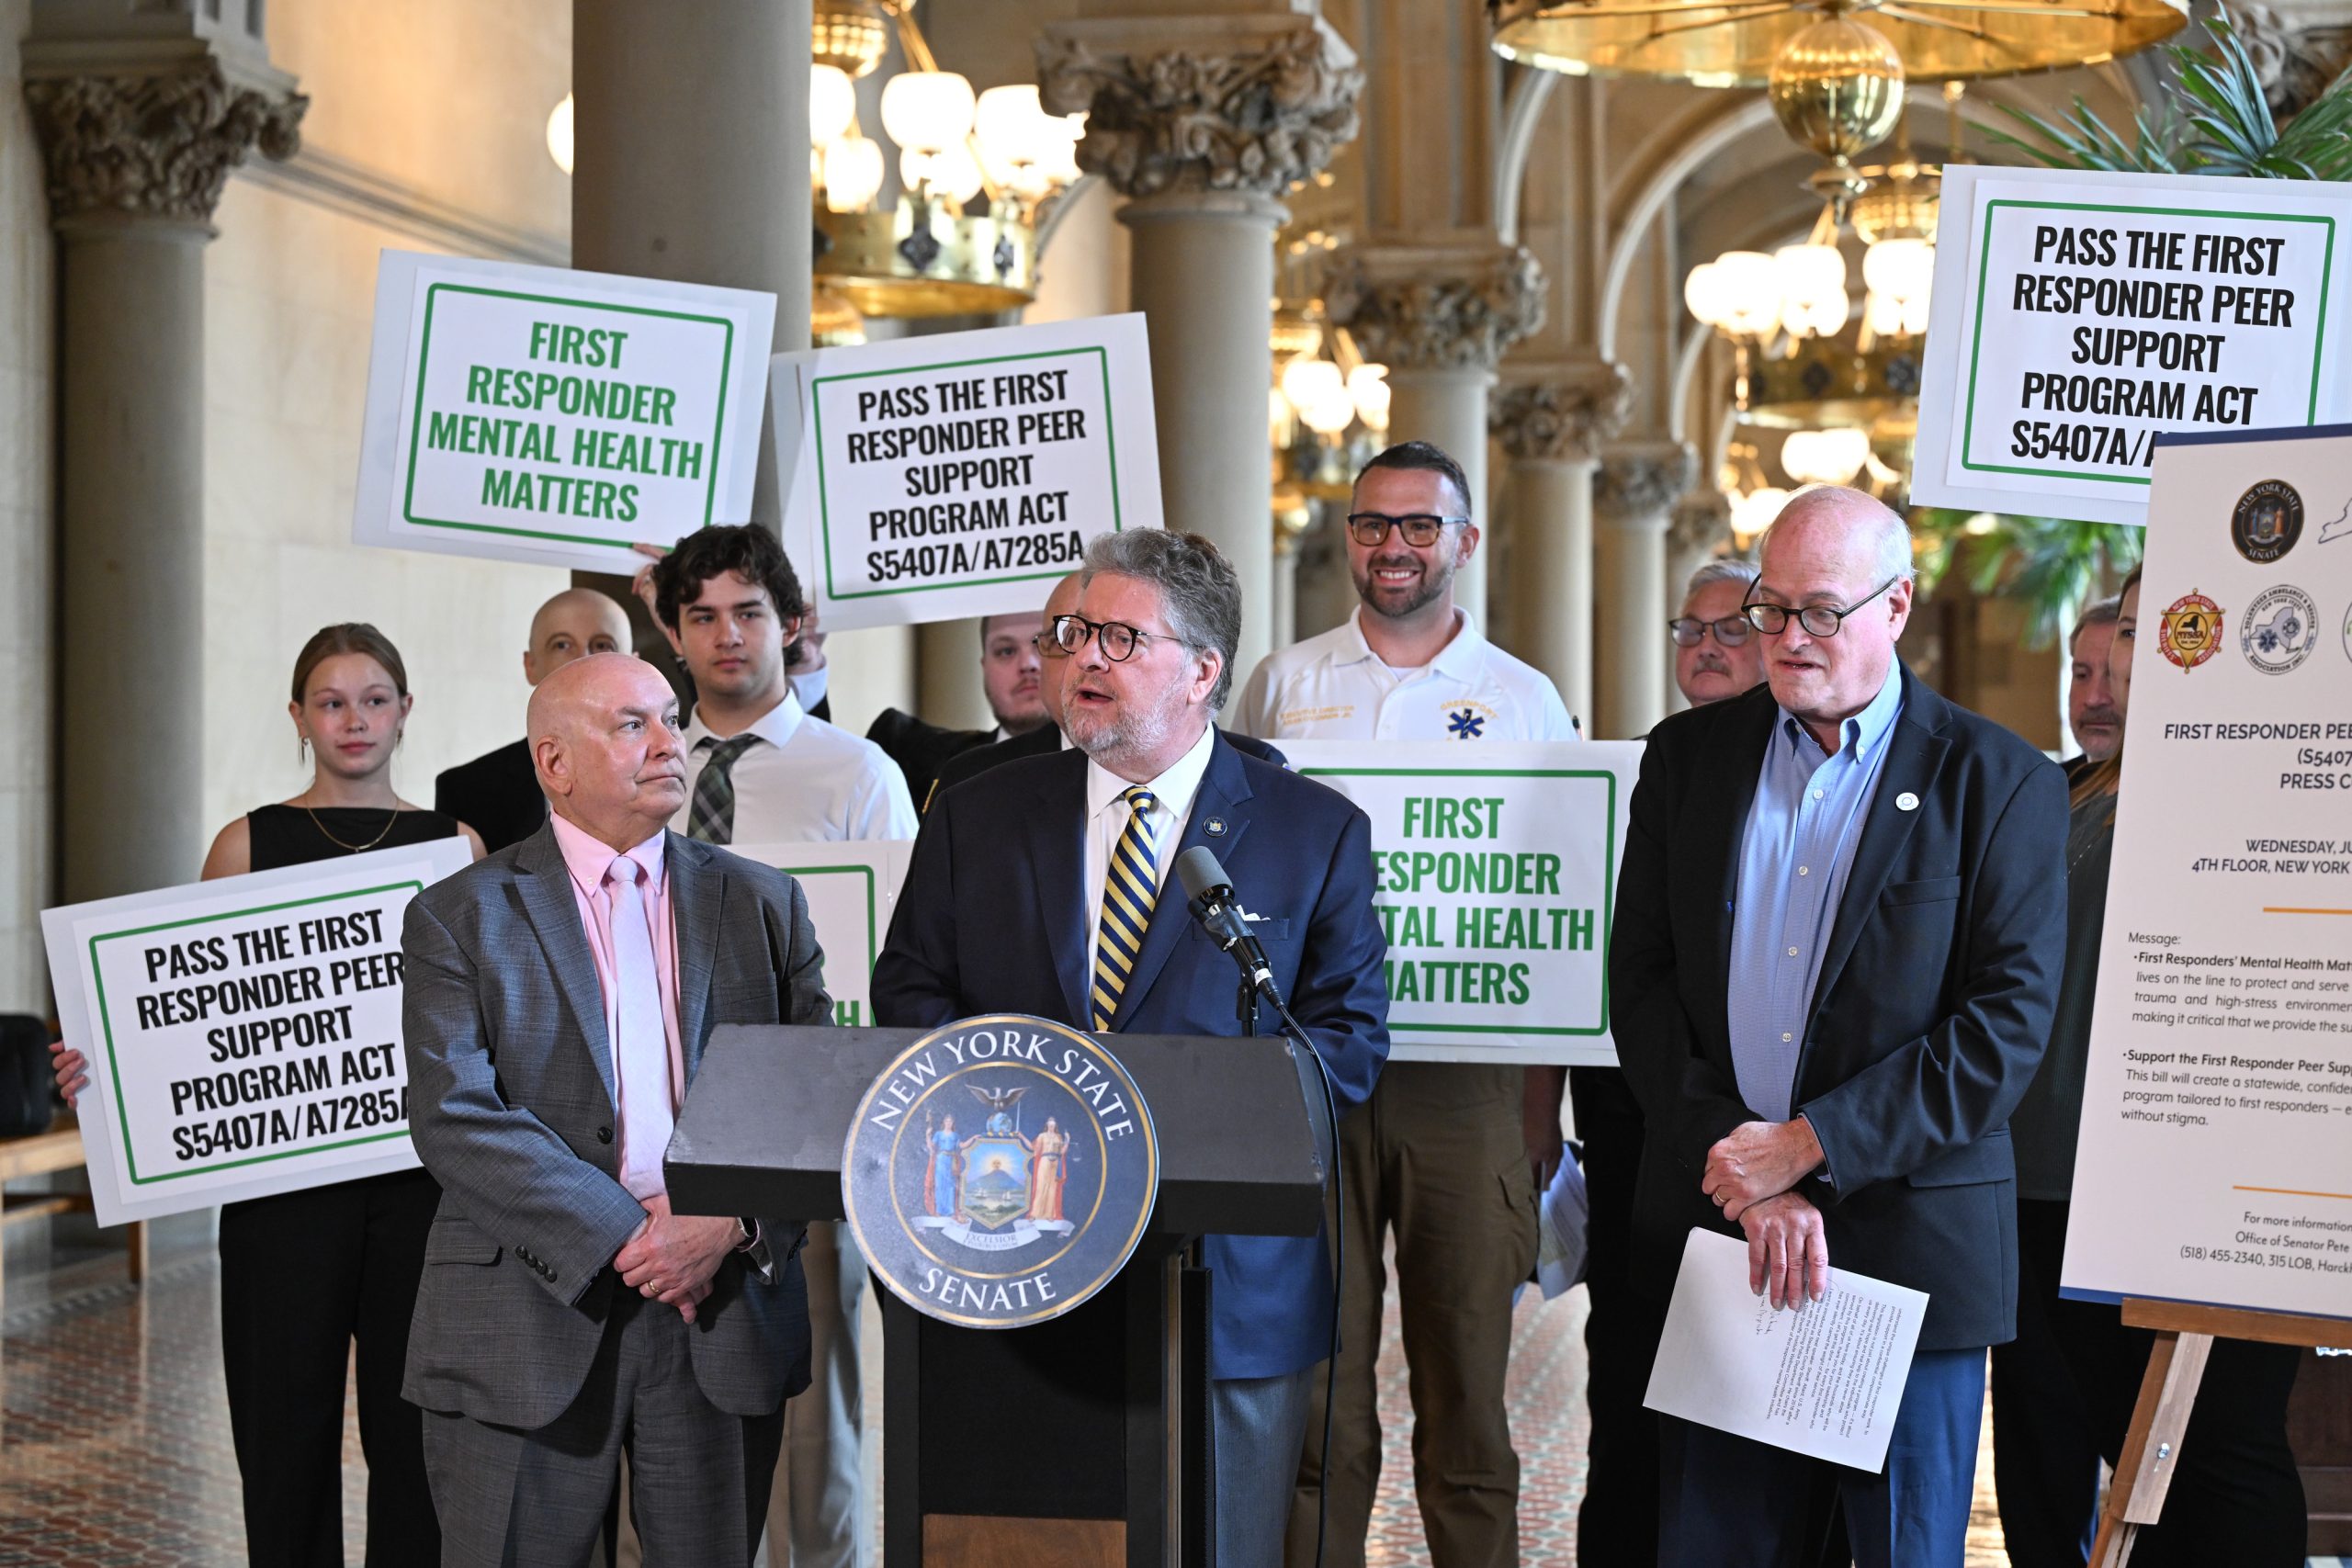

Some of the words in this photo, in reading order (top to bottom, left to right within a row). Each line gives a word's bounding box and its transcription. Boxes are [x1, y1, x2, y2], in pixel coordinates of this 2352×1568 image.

[2034, 226, 2117, 266] PASS
[2126, 231, 2186, 271] THE
[2192, 234, 2286, 276] FIRST
[2013, 274, 2203, 321] RESPONDER
[2211, 285, 2295, 328] PEER
[529, 321, 628, 369] FIRST
[2072, 326, 2225, 373] SUPPORT
[467, 365, 676, 426] RESPONDER
[858, 386, 930, 423] PASS
[935, 378, 987, 413] THE
[994, 369, 1068, 407] FIRST
[2021, 372, 2186, 421] PROGRAM
[2192, 384, 2258, 425] ACT
[428, 412, 560, 463] MENTAL
[572, 428, 703, 479] HEALTH
[847, 417, 1010, 464] RESPONDER
[1018, 409, 1086, 445] PEER
[481, 468, 639, 522] MATTERS
[905, 454, 1034, 497] SUPPORT
[2256, 483, 2280, 494] YORK
[869, 498, 1009, 542] PROGRAM
[1018, 491, 1069, 525] ACT
[867, 530, 1087, 582] S5407A/A7285A
[2247, 547, 2278, 559] SENATE
[2244, 595, 2267, 630] VOLUNTEER
[2267, 588, 2304, 599] AMBULANCE
[2249, 653, 2291, 672] ASSOCIATION
[2165, 724, 2212, 739] FIRST
[2216, 724, 2321, 739] RESPONDER
[2280, 773, 2335, 789] PRESS
[1404, 797, 1505, 839] FIRST
[2192, 858, 2218, 873] 4TH
[2222, 858, 2270, 873] FLOOR,
[2275, 860, 2310, 873] NEW
[2312, 861, 2350, 874] YORK
[2245, 840, 2335, 854] WEDNESDAY,
[1371, 851, 1561, 897] ESPONDER
[144, 937, 229, 983] PASS
[232, 925, 294, 966] THE
[299, 908, 382, 955] FIRST
[1456, 908, 1594, 951] HEALTH
[2128, 931, 2181, 948] Message:
[2136, 971, 2160, 983] lives
[2164, 975, 2179, 984] on
[2183, 974, 2201, 985] the
[2205, 975, 2225, 987] line
[2230, 976, 2242, 987] to
[2245, 978, 2288, 990] protect
[2291, 979, 2315, 990] and
[2319, 982, 2349, 992] serve
[2139, 952, 2164, 964] First
[2165, 953, 2238, 968] Responders'
[2240, 956, 2281, 968] Mental
[2284, 958, 2324, 970] Health
[136, 966, 324, 1031] RESPONDER
[330, 948, 406, 996] PEER
[2135, 992, 2177, 1004] trauma
[2185, 995, 2208, 1005] and
[2216, 995, 2278, 1010] high-stress
[207, 1005, 352, 1063] SUPPORT
[2132, 1011, 2175, 1027] making
[2177, 1013, 2185, 1023] it
[2187, 1014, 2225, 1026] critical
[2228, 1016, 2251, 1027] that
[2254, 1020, 2270, 1029] we
[2272, 1020, 2316, 1032] provide
[2319, 1021, 2338, 1032] the
[170, 1055, 332, 1116] PROGRAM
[342, 1043, 395, 1086] ACT
[2126, 1068, 2148, 1081] This
[2152, 1071, 2168, 1082] bill
[2171, 1073, 2190, 1084] will
[2193, 1076, 2229, 1087] create
[2233, 1078, 2241, 1088] a
[2244, 1078, 2302, 1092] statewide,
[2128, 1049, 2176, 1065] Support
[2179, 1053, 2198, 1065] the
[2201, 1054, 2227, 1066] First
[2230, 1055, 2294, 1071] Responder
[2298, 1060, 2324, 1072] Peer
[870, 1049, 937, 1132] NEW
[943, 1030, 1053, 1066] YORK
[1055, 1048, 1135, 1142] STATE
[2122, 1091, 2174, 1104] program
[2177, 1093, 2222, 1106] tailored
[2224, 1097, 2236, 1108] to
[2240, 1097, 2261, 1109] first
[2264, 1100, 2328, 1113] responders
[2121, 1110, 2165, 1122] without
[2166, 1112, 2209, 1127] stigma.
[2244, 1211, 2260, 1224] For
[2263, 1217, 2290, 1227] more
[2180, 1246, 2207, 1260] (518)
[2210, 1249, 2266, 1267] 455-2340,
[2268, 1255, 2286, 1268] 315
[2288, 1257, 2314, 1271] LOB,
[2235, 1231, 2267, 1246] Office
[2269, 1235, 2281, 1246] of
[2283, 1235, 2324, 1250] Senator
[2326, 1239, 2349, 1253] Pete
[919, 1267, 1057, 1312] SENATE
